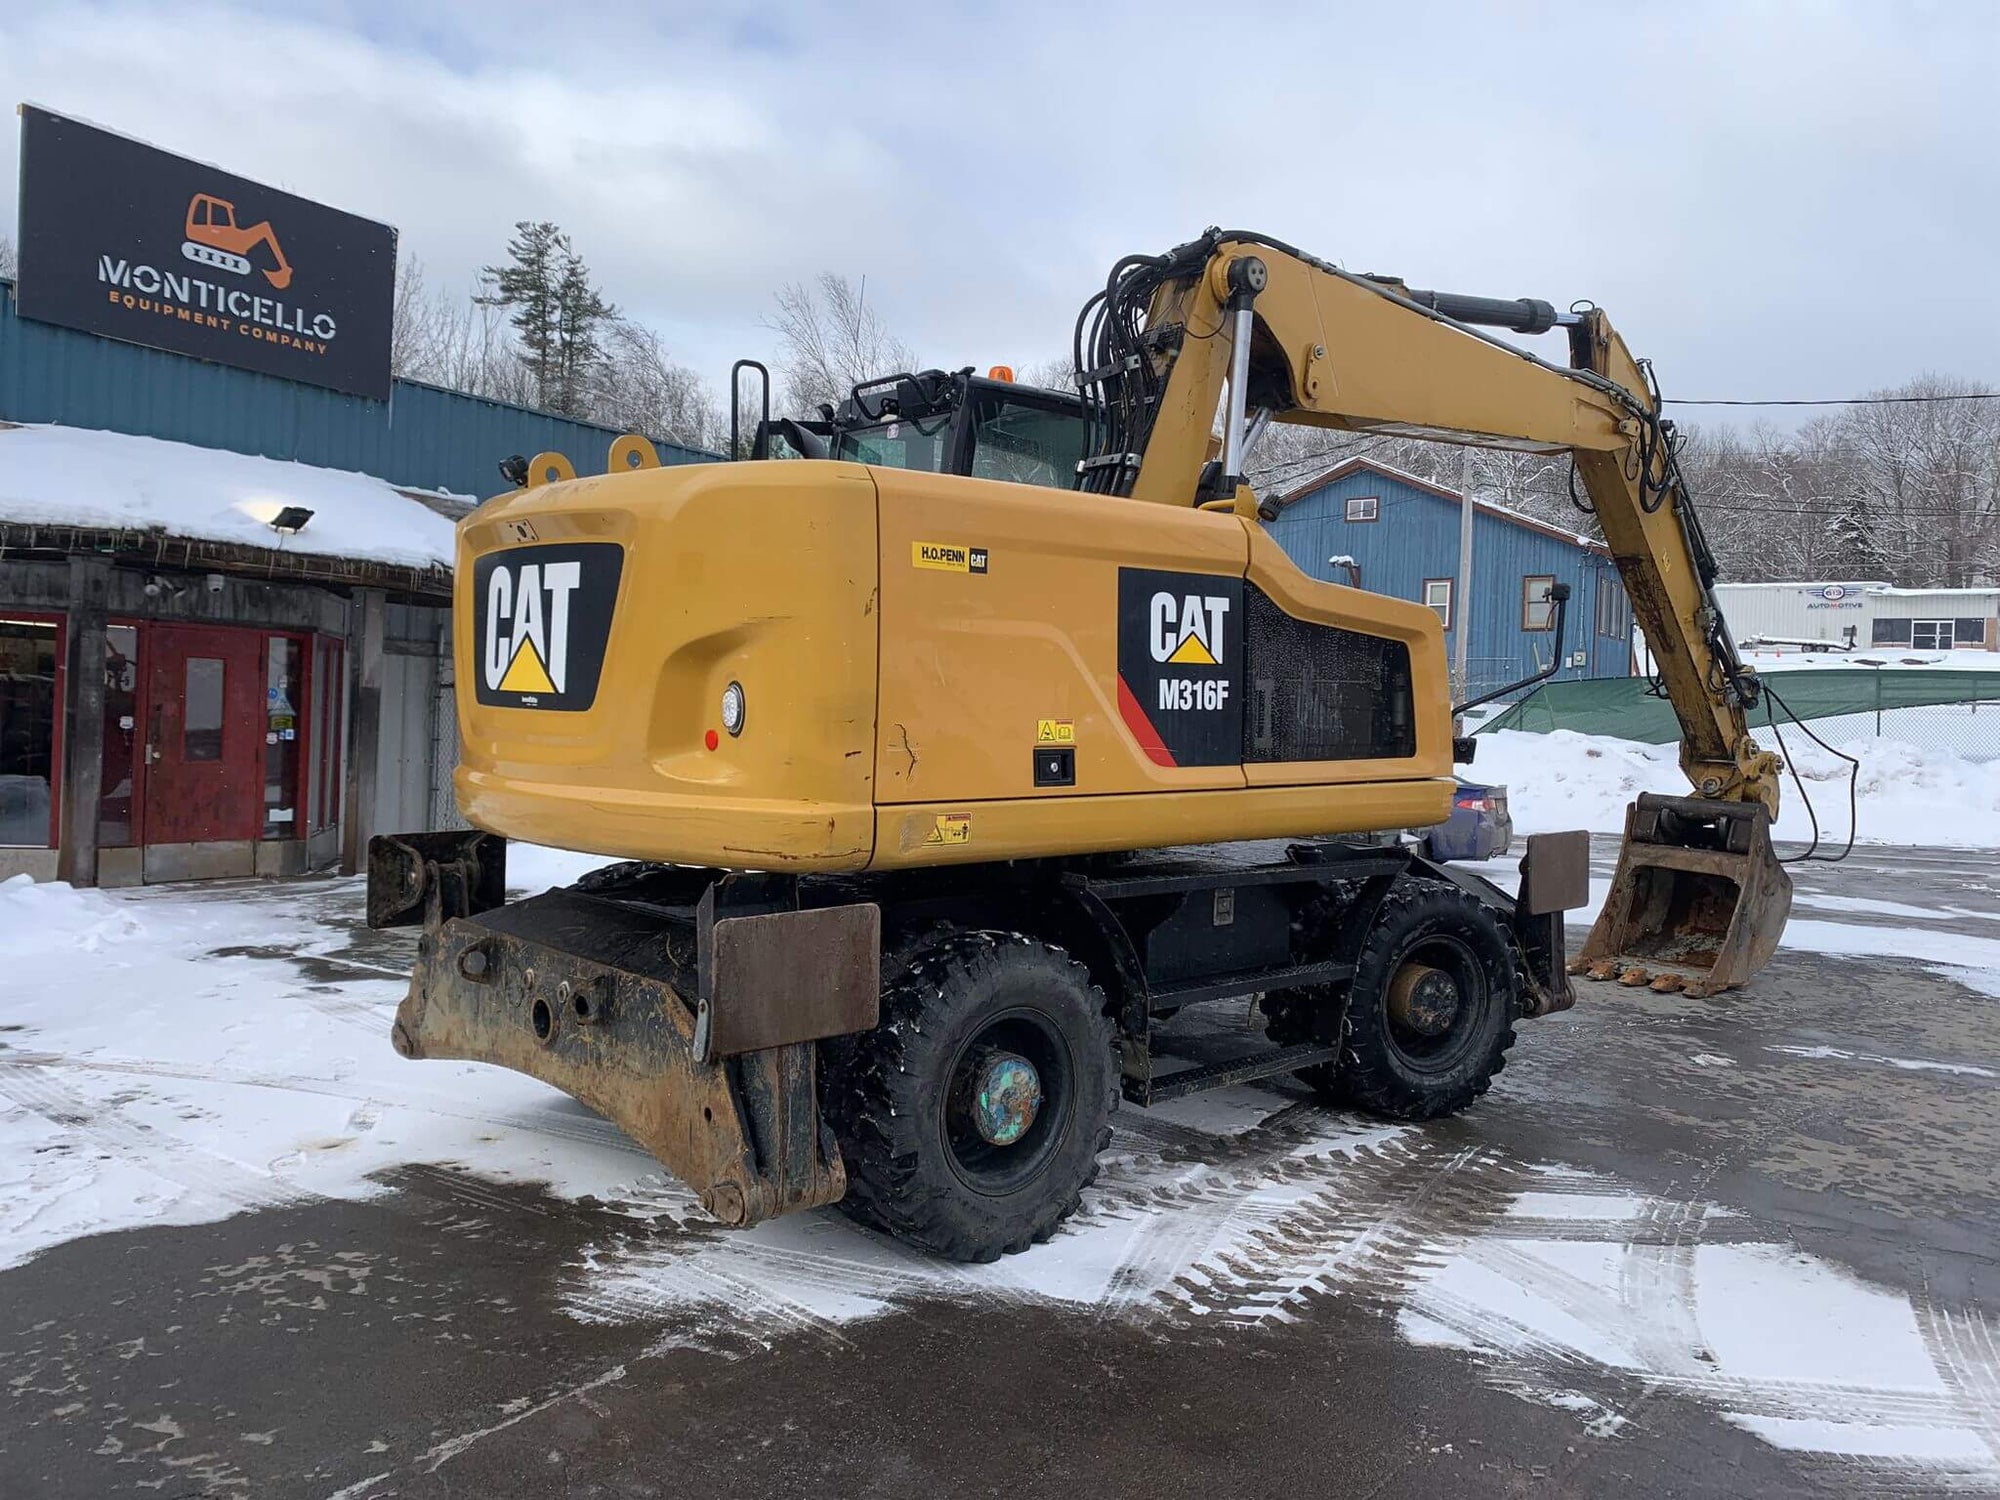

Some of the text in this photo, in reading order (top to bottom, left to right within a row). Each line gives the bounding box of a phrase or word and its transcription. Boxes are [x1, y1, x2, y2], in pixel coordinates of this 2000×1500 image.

[98, 255, 337, 340] MONTICELLO
[109, 290, 328, 354] EQUIPMENT COMPANY
[970, 553, 987, 568] CAT
[485, 561, 581, 694] CAT
[1150, 591, 1230, 665] CAT
[1806, 602, 1863, 610] AUTOMOTIVE
[1158, 679, 1230, 711] M316F
